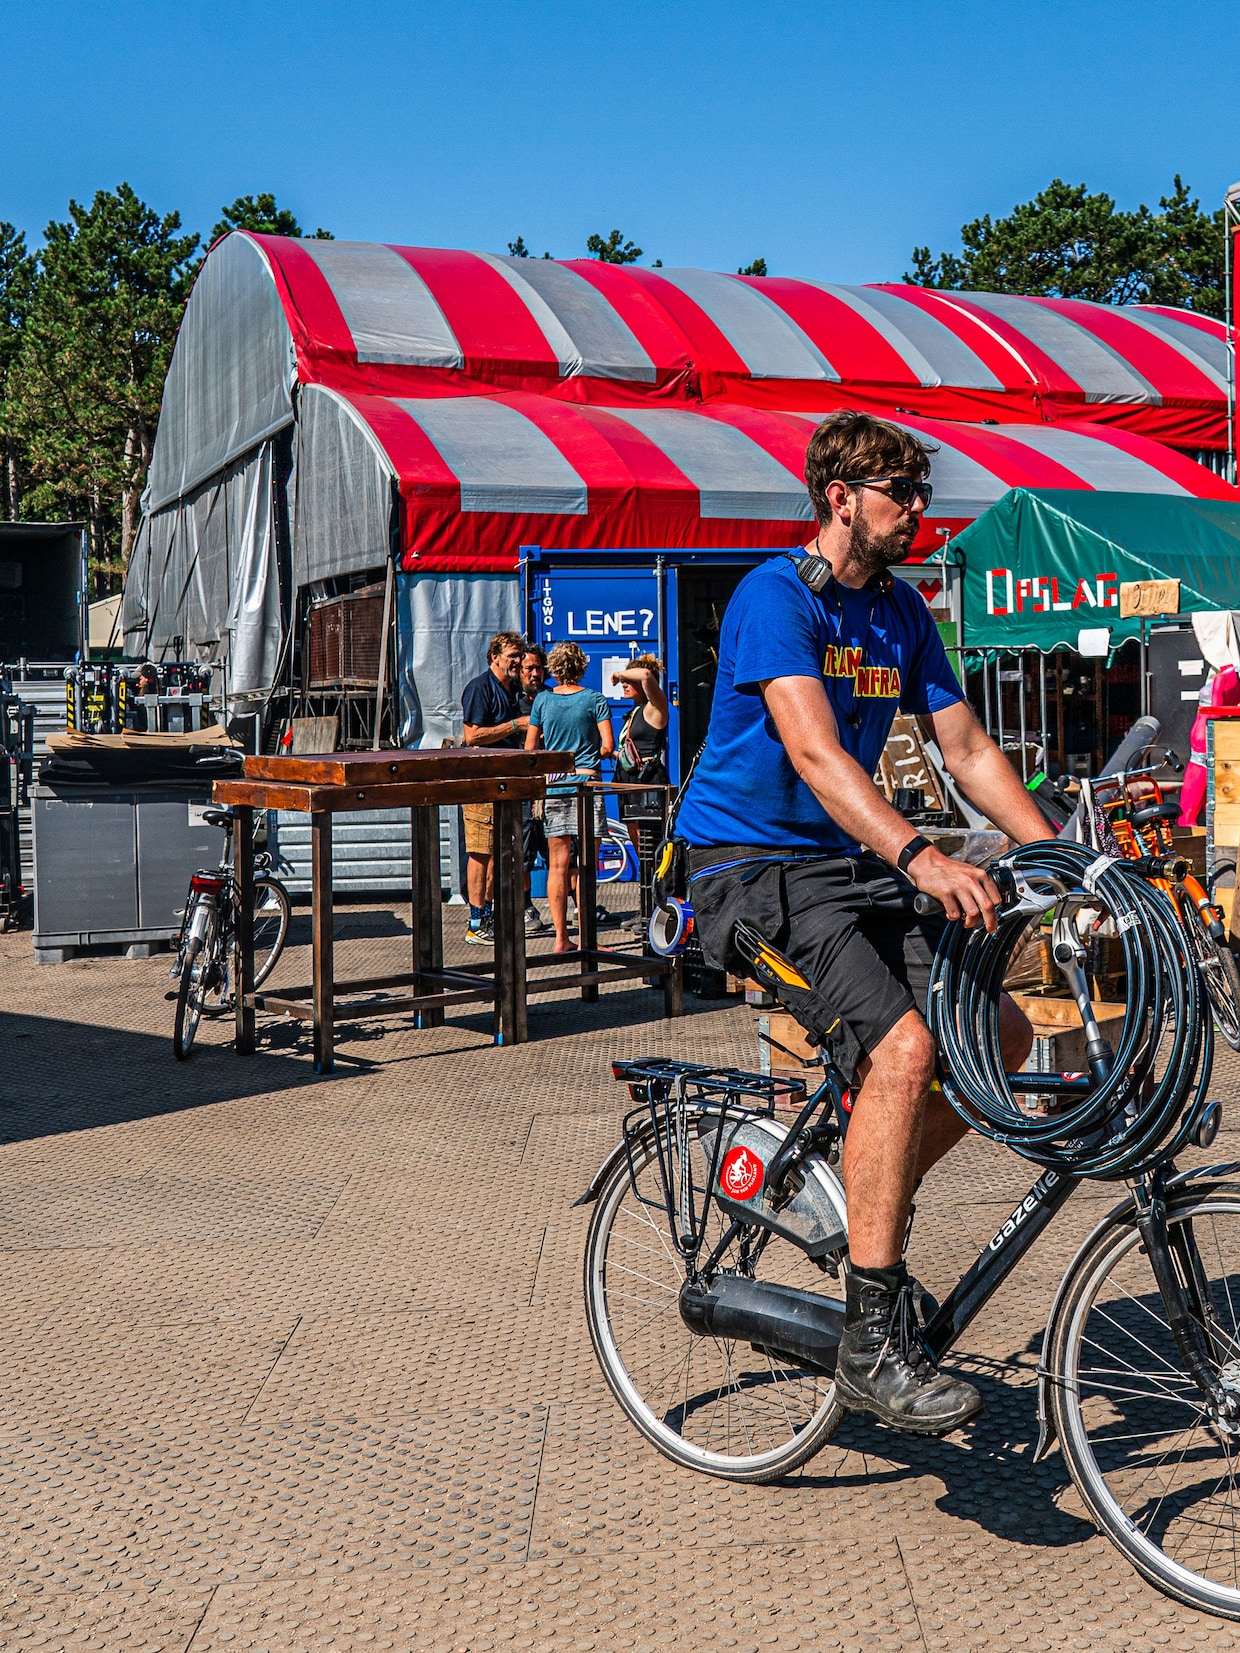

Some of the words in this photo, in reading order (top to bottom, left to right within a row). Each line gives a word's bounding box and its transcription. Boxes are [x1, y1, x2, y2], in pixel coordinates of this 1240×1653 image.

[542, 579, 554, 625] ITGWO
[986, 567, 1118, 616] OPSLAG
[545, 631, 552, 641] 1
[567, 608, 654, 637] LENE?
[854, 667, 901, 698] NFRA
[989, 1169, 1060, 1251] Gazelle
